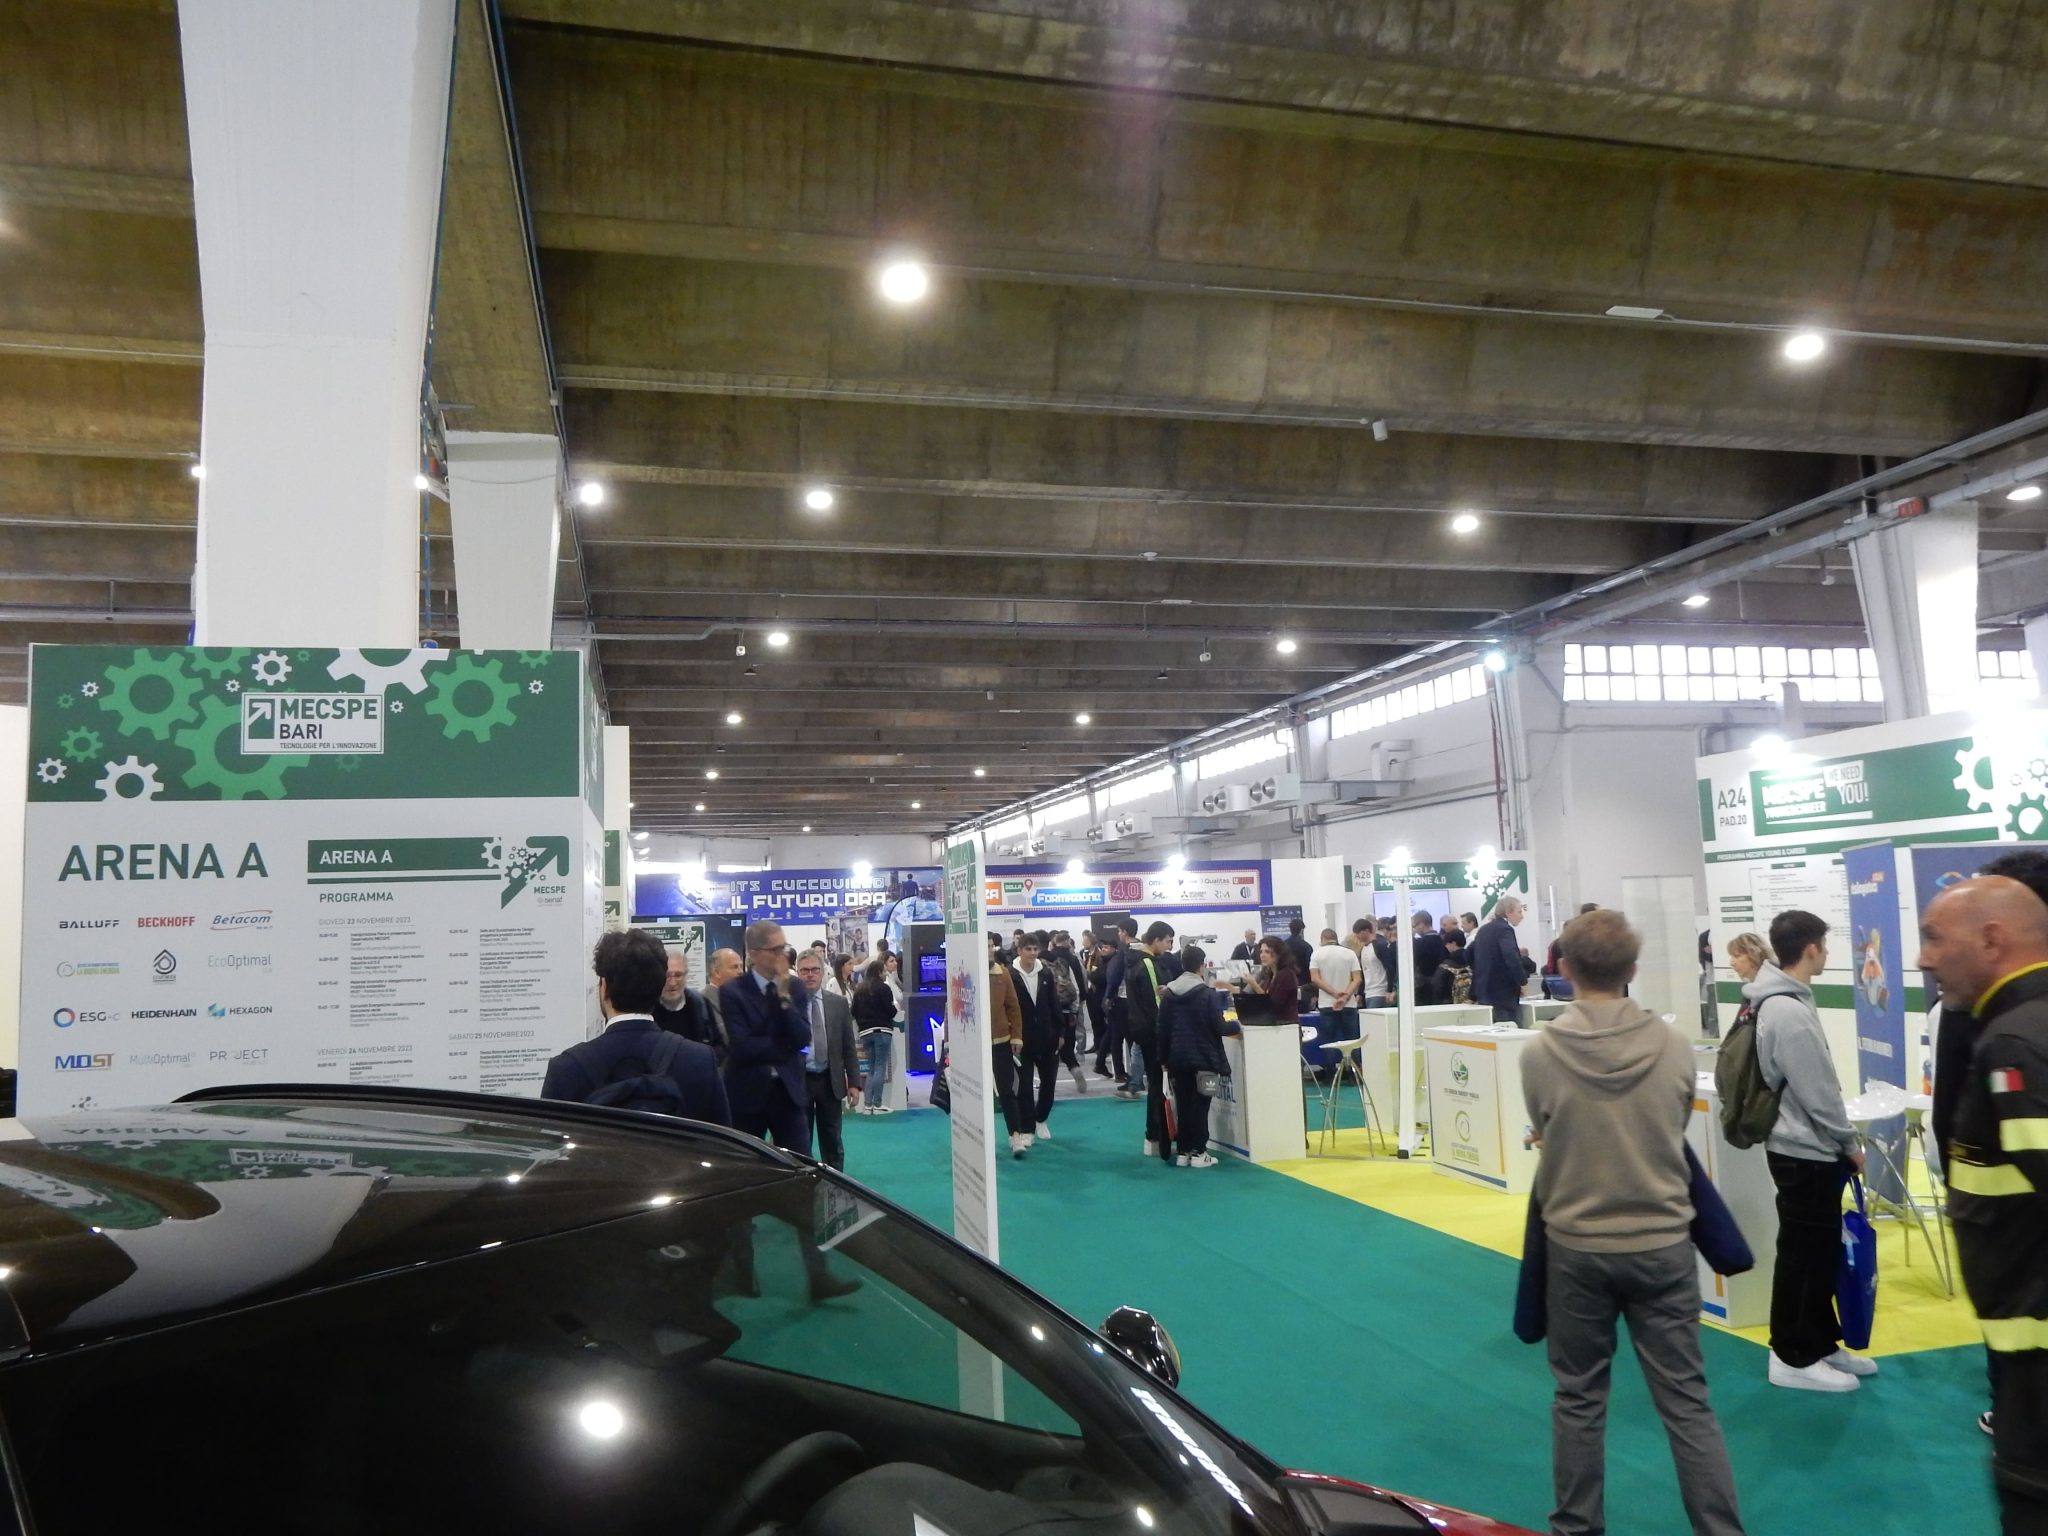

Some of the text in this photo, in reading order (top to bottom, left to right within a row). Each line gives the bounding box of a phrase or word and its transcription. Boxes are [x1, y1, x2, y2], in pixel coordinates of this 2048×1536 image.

[280, 698, 378, 720] MECSPE
[280, 723, 323, 740] BARI
[1840, 764, 1861, 780] NEED
[1717, 786, 1747, 810] A24
[1837, 781, 1870, 805] YOU!
[1719, 814, 1748, 828] PAD.20
[58, 842, 269, 882] ARENA A
[319, 849, 393, 866] ARENA A
[1354, 870, 1372, 880] A28
[1409, 866, 1436, 876] DELLA
[730, 878, 887, 892] ITS CUCCOVIO
[1434, 876, 1447, 886] 4.0
[319, 891, 394, 903] PROGRAMMA
[533, 886, 567, 895] MECSPE
[1111, 881, 1140, 900] 4.0
[731, 891, 887, 910] IL FUTURO.ORA
[59, 919, 120, 929] BALLUFF
[137, 916, 196, 928] BECKHOFF
[211, 914, 272, 926] Betacom
[347, 917, 355, 925] 23
[356, 916, 393, 925] NOVEMBRE
[207, 953, 272, 970] EcoOptimal
[131, 1008, 197, 1019] HEIDENHAIN
[229, 1006, 273, 1015] HEXAGON
[448, 1030, 536, 1041] SABATO 25 NOVEMBRE 2023
[348, 1046, 357, 1055] 24
[357, 1045, 396, 1054] NOVEMBRE
[397, 1044, 413, 1052] 2023
[55, 1054, 115, 1070] MOST
